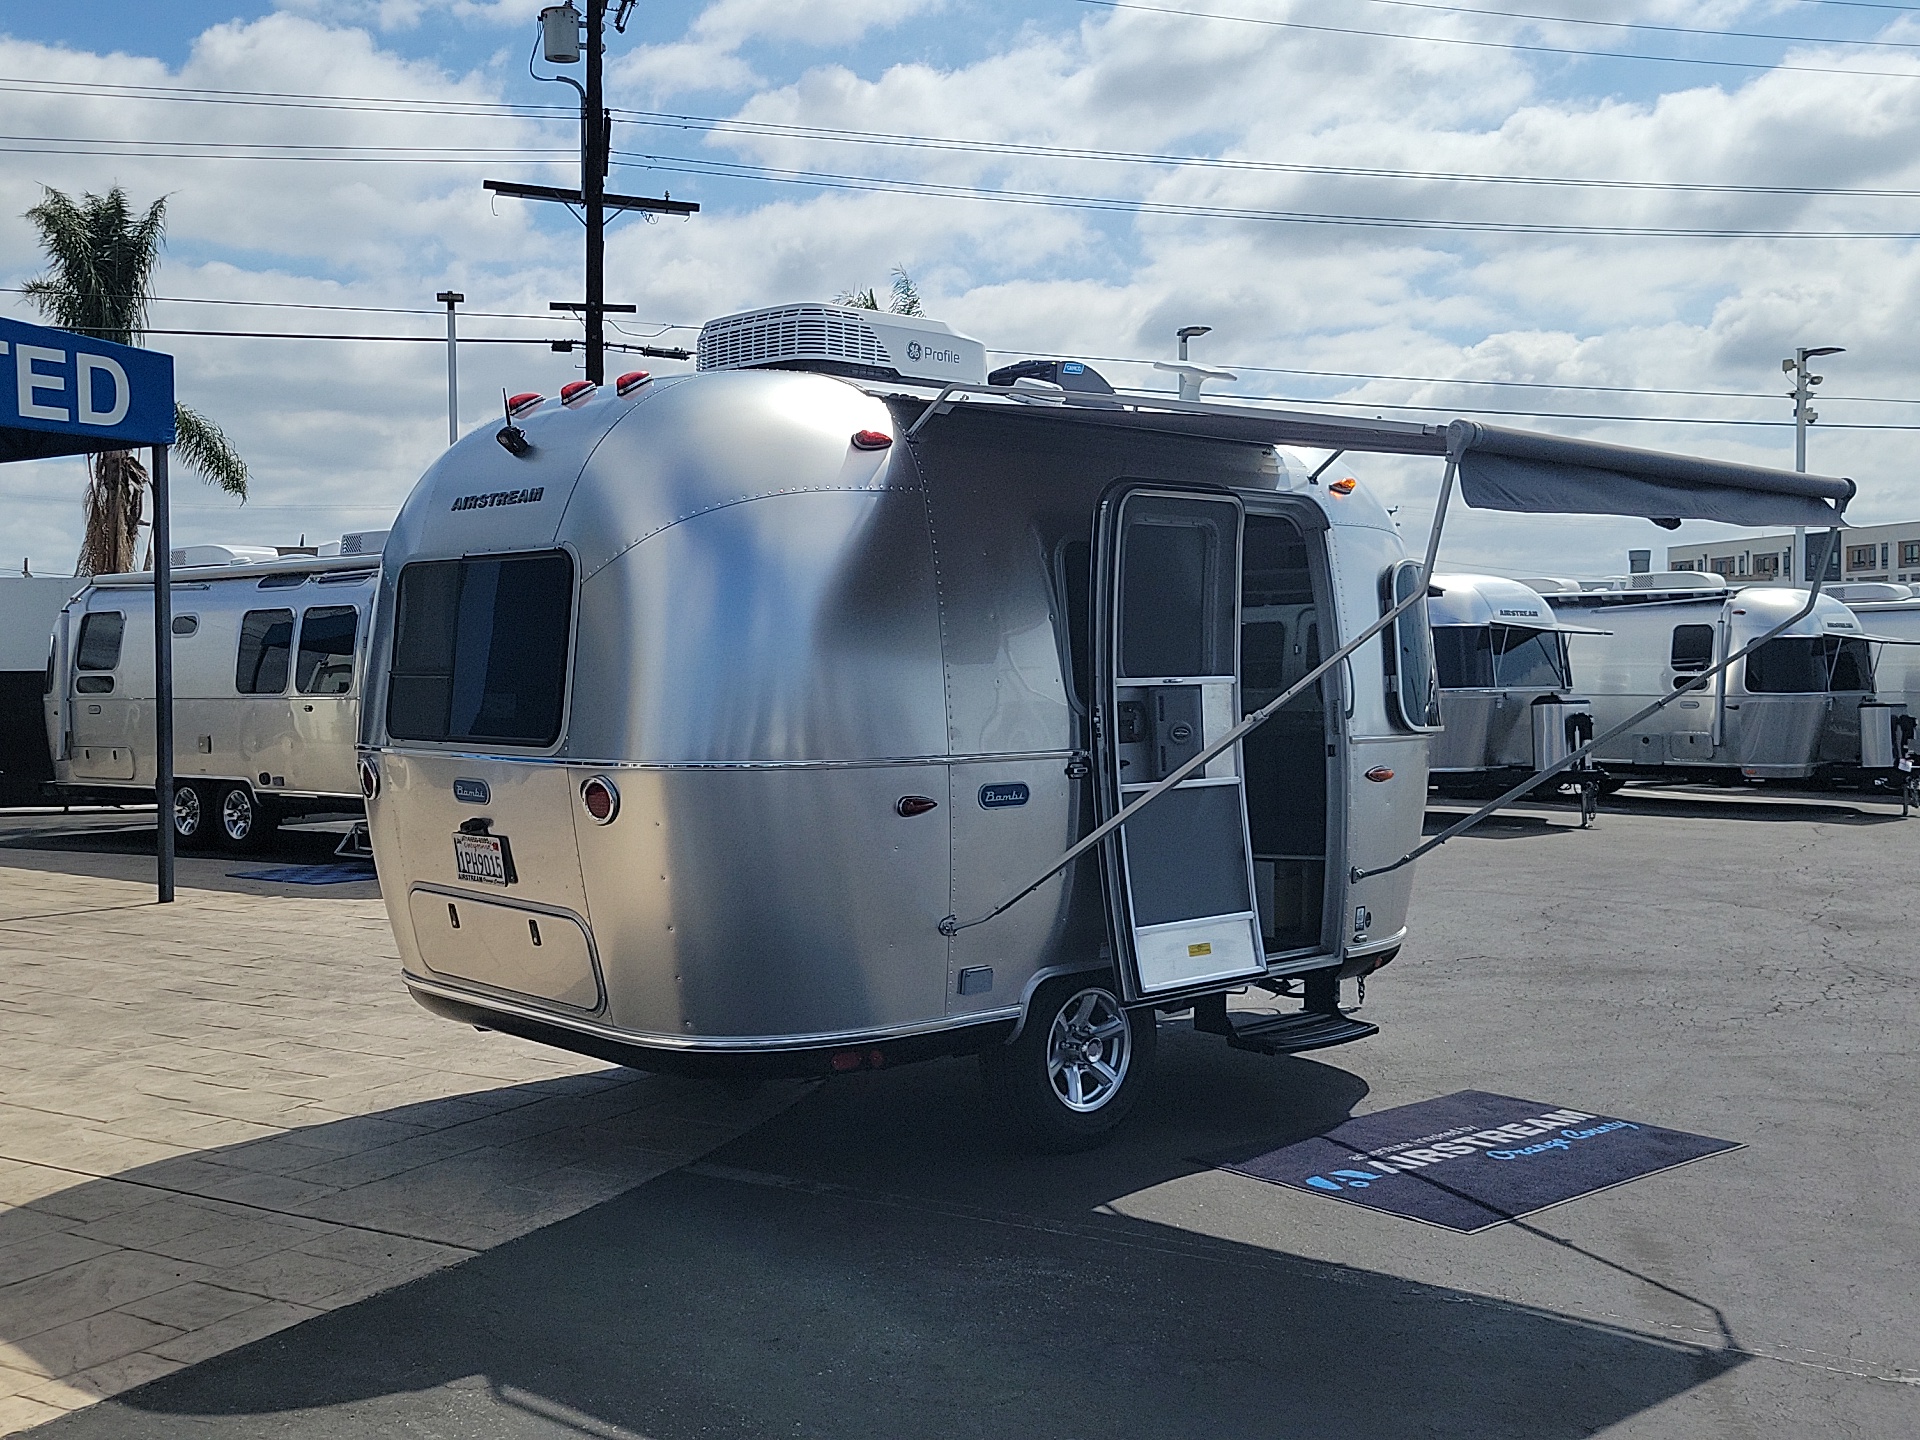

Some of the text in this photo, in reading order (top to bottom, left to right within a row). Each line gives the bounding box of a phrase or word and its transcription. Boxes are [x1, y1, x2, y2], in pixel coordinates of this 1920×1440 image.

[924, 346, 960, 364] Profile
[0, 341, 130, 426] ED
[451, 487, 544, 511] AIRSTREAM
[456, 785, 485, 798] Bambi
[985, 791, 1025, 802] Bambi
[459, 851, 503, 878] 1PH9015
[1367, 1109, 1597, 1174] AIRSTREAM
[1486, 1120, 1639, 1160] Orange County
